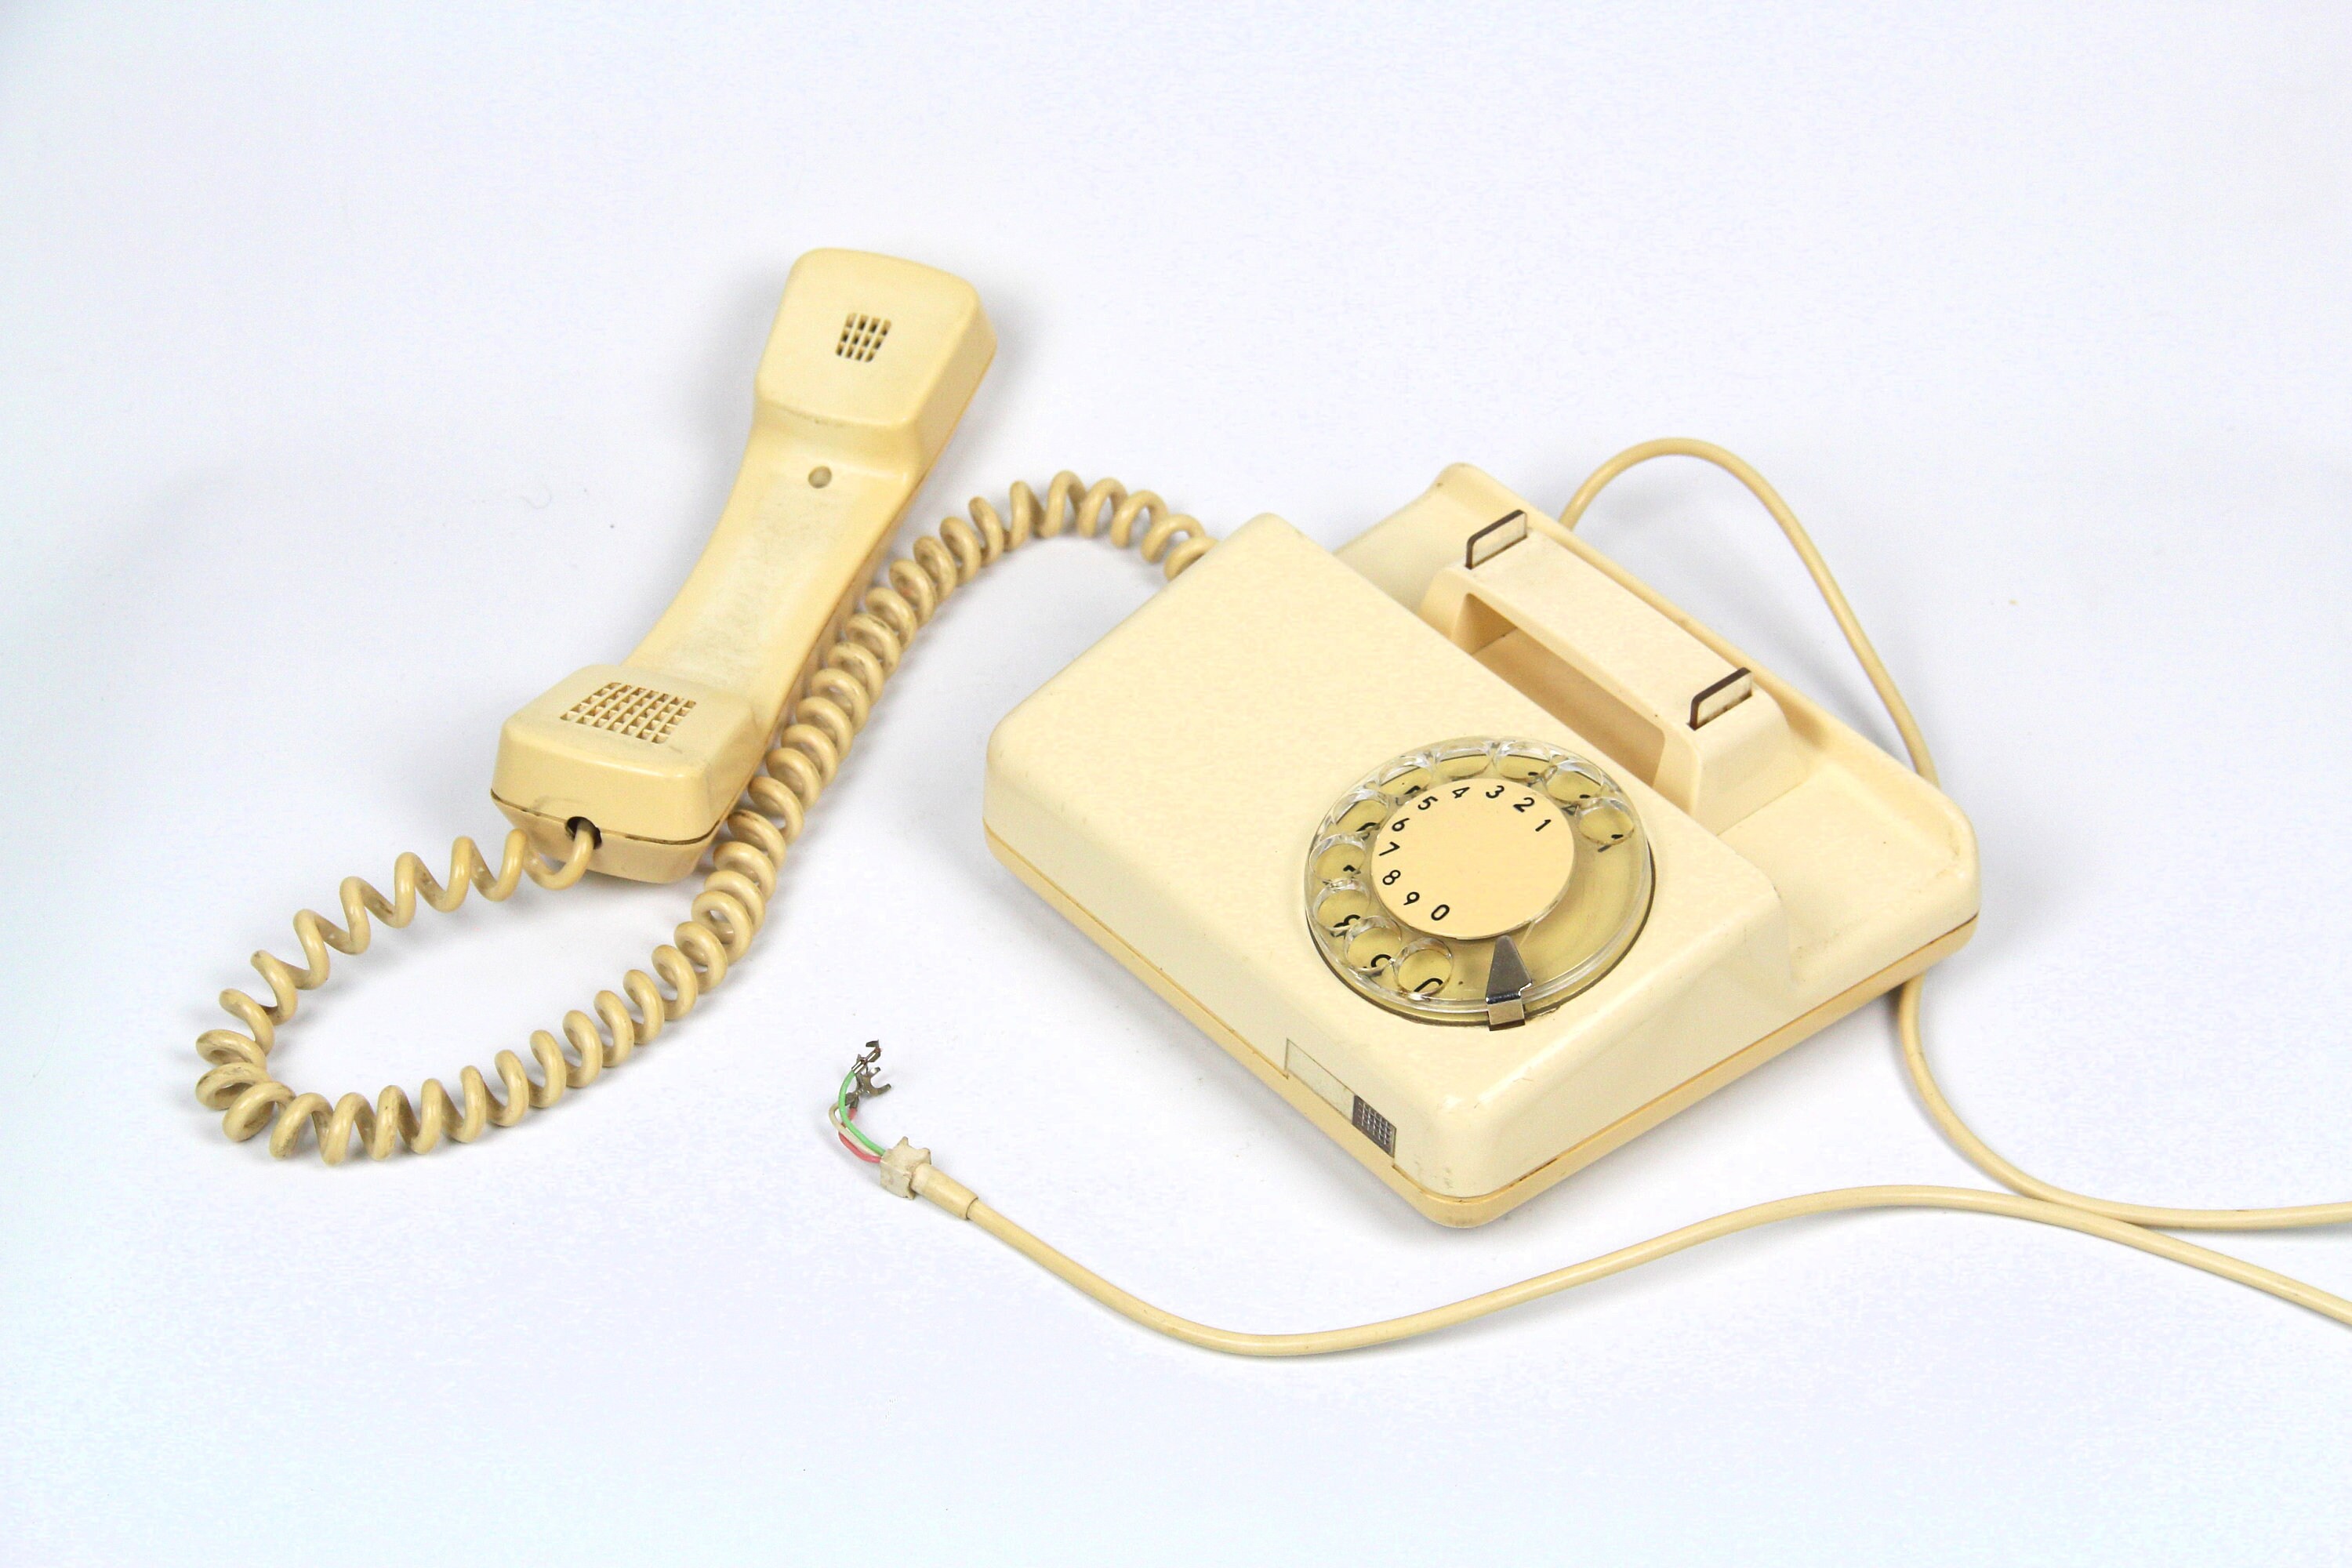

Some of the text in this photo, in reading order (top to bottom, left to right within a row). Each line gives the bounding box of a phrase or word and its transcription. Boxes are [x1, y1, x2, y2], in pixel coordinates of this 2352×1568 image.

[1452, 786, 1470, 799] 4
[1485, 785, 1505, 799] 3
[1417, 796, 1439, 811] 5
[1513, 797, 1535, 813] 2
[1392, 818, 1410, 832] 6
[1535, 818, 1552, 832] 1
[1378, 841, 1400, 857] 7
[1382, 869, 1401, 886] 8
[1403, 891, 1421, 906] 9
[1431, 904, 1450, 921] 0
